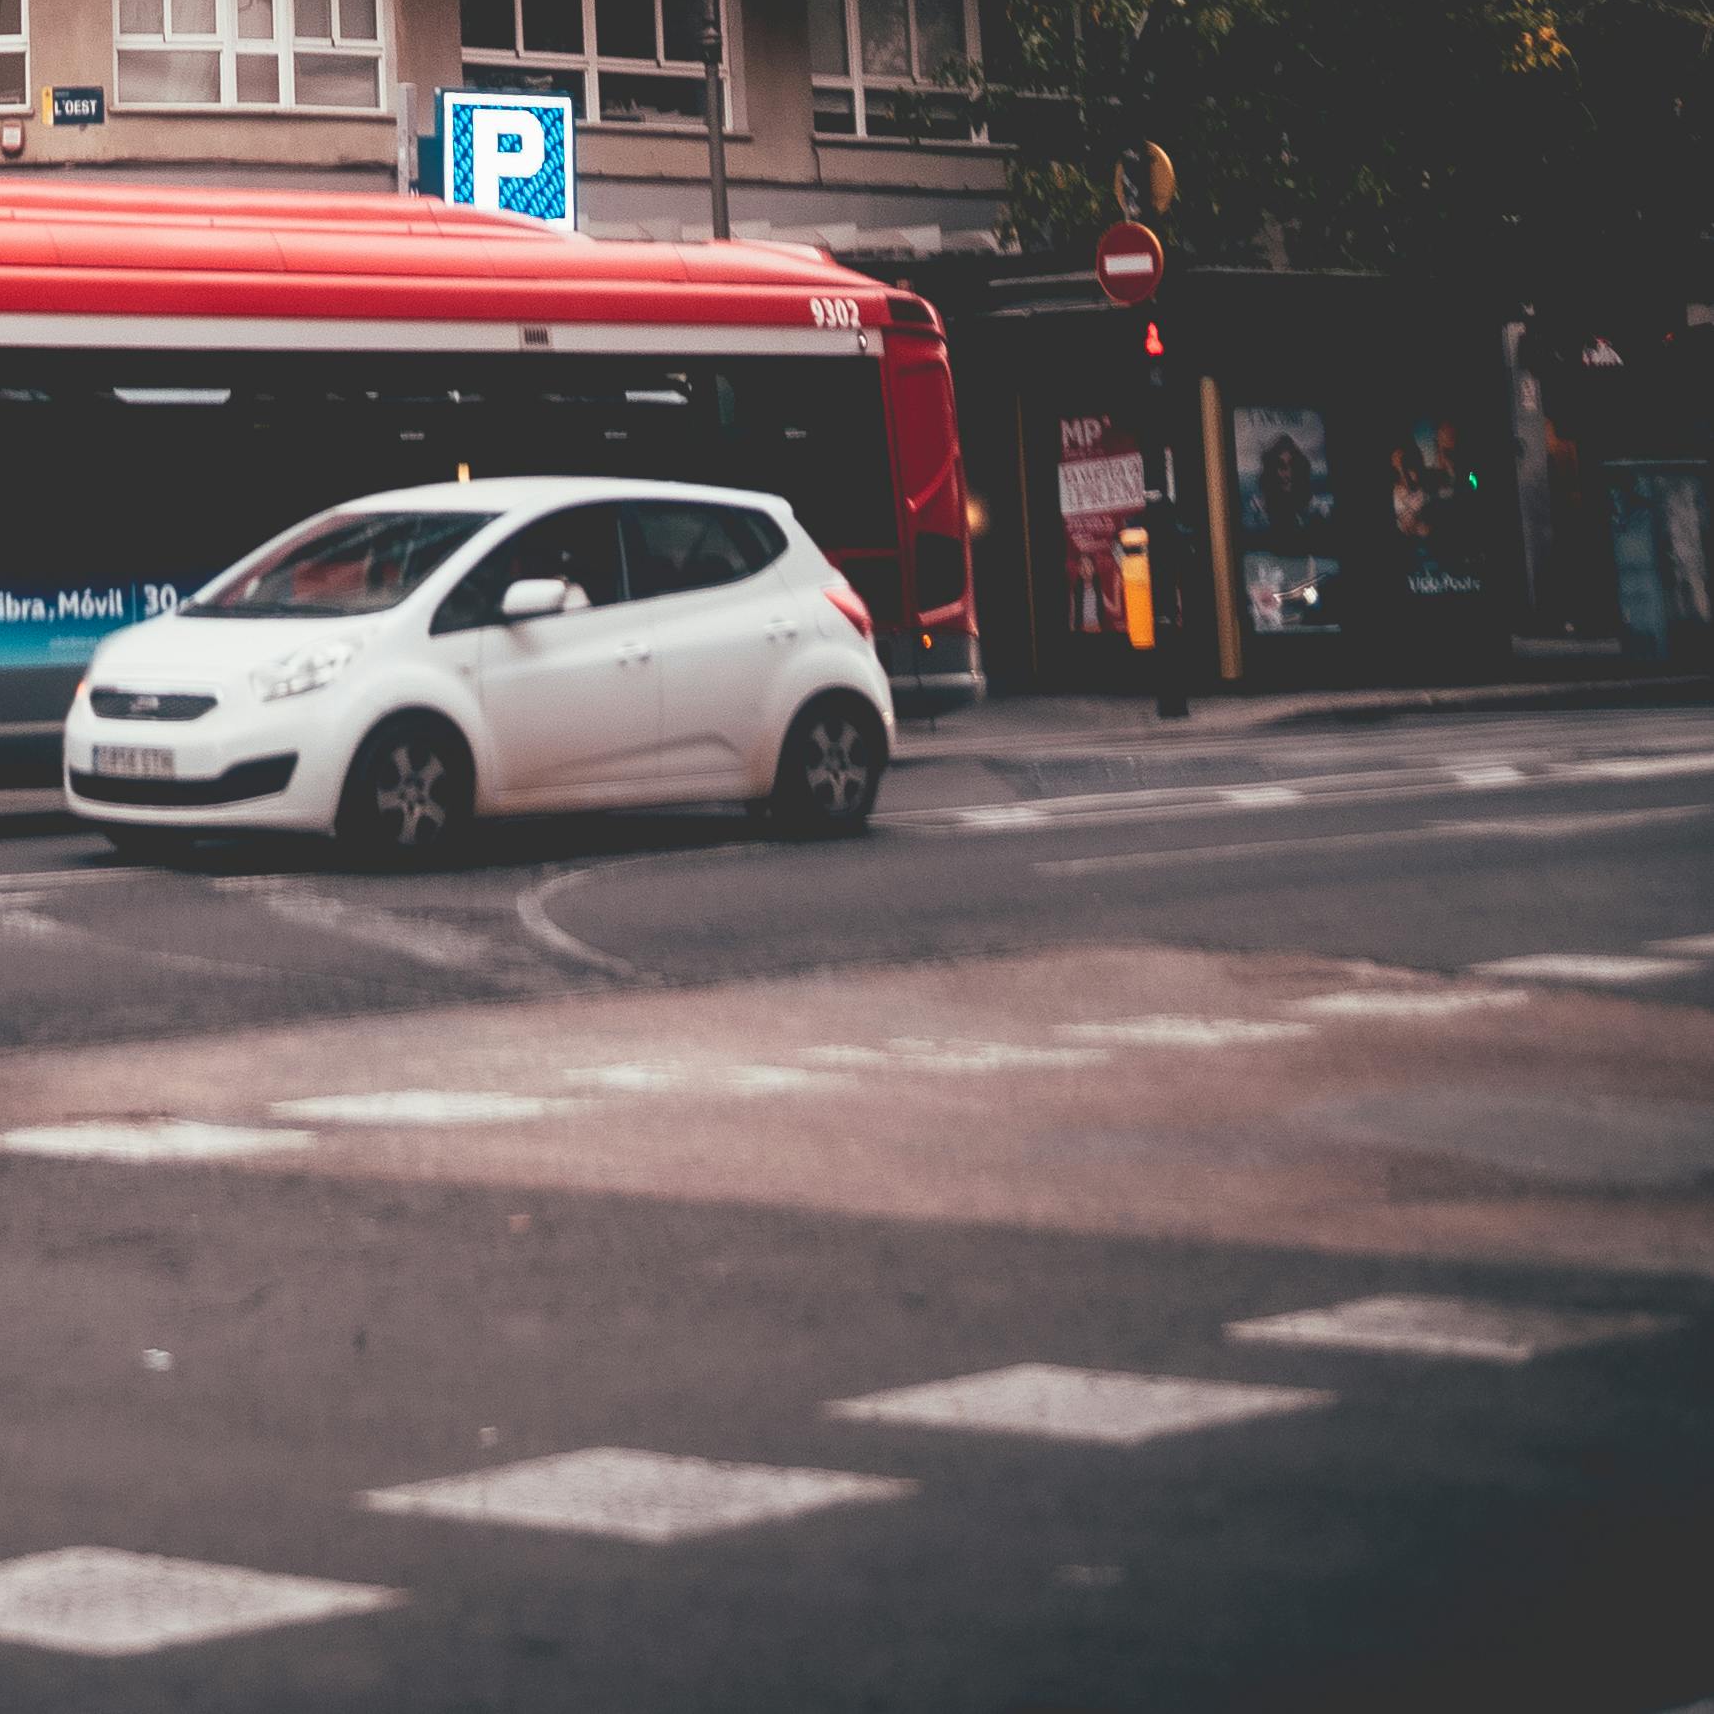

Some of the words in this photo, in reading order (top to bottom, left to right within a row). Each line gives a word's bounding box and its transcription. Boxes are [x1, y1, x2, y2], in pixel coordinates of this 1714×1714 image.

[54, 99, 98, 117] L'OEST
[472, 108, 545, 211] P
[809, 297, 862, 328] 9302
[57, 587, 124, 620] Móvil
